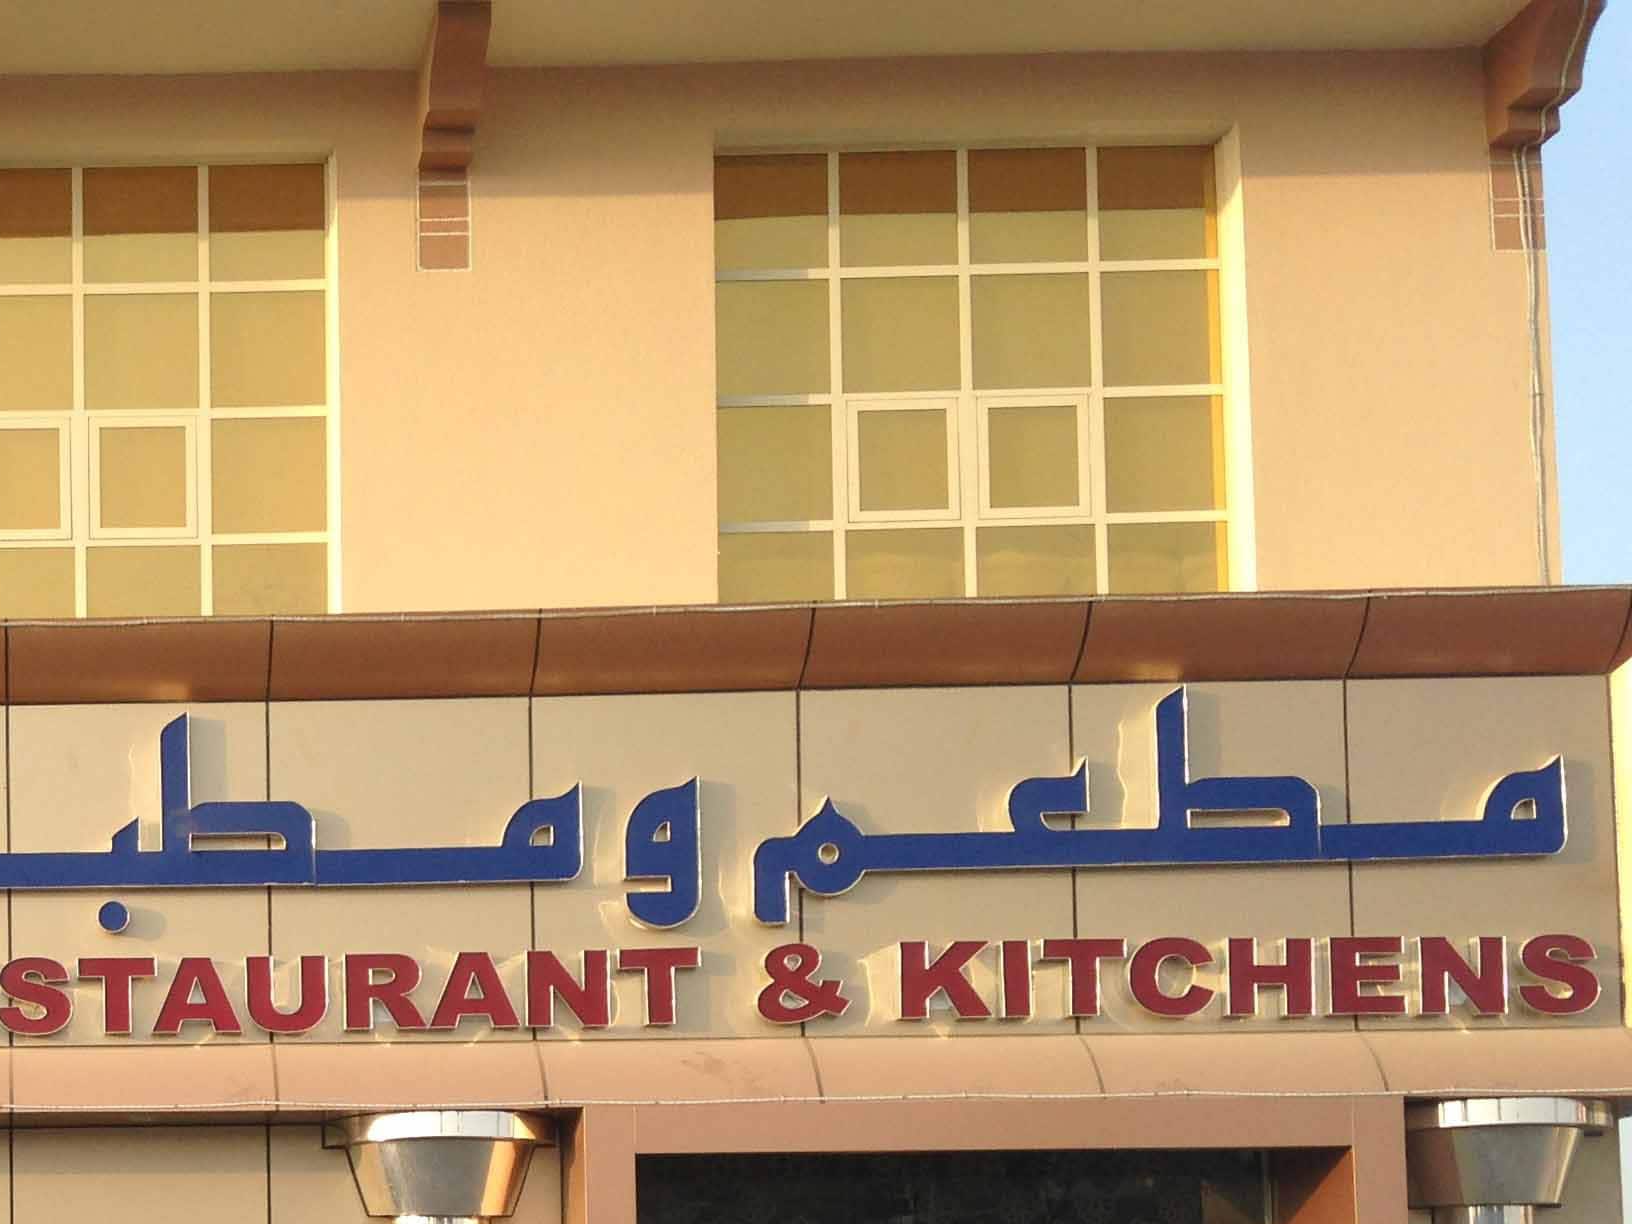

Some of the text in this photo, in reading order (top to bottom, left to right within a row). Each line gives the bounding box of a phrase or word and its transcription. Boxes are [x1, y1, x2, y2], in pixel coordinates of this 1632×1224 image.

[753, 684, 1568, 926] مطعم
[757, 942, 851, 1024] &
[899, 934, 1602, 1021] KITCHENS
